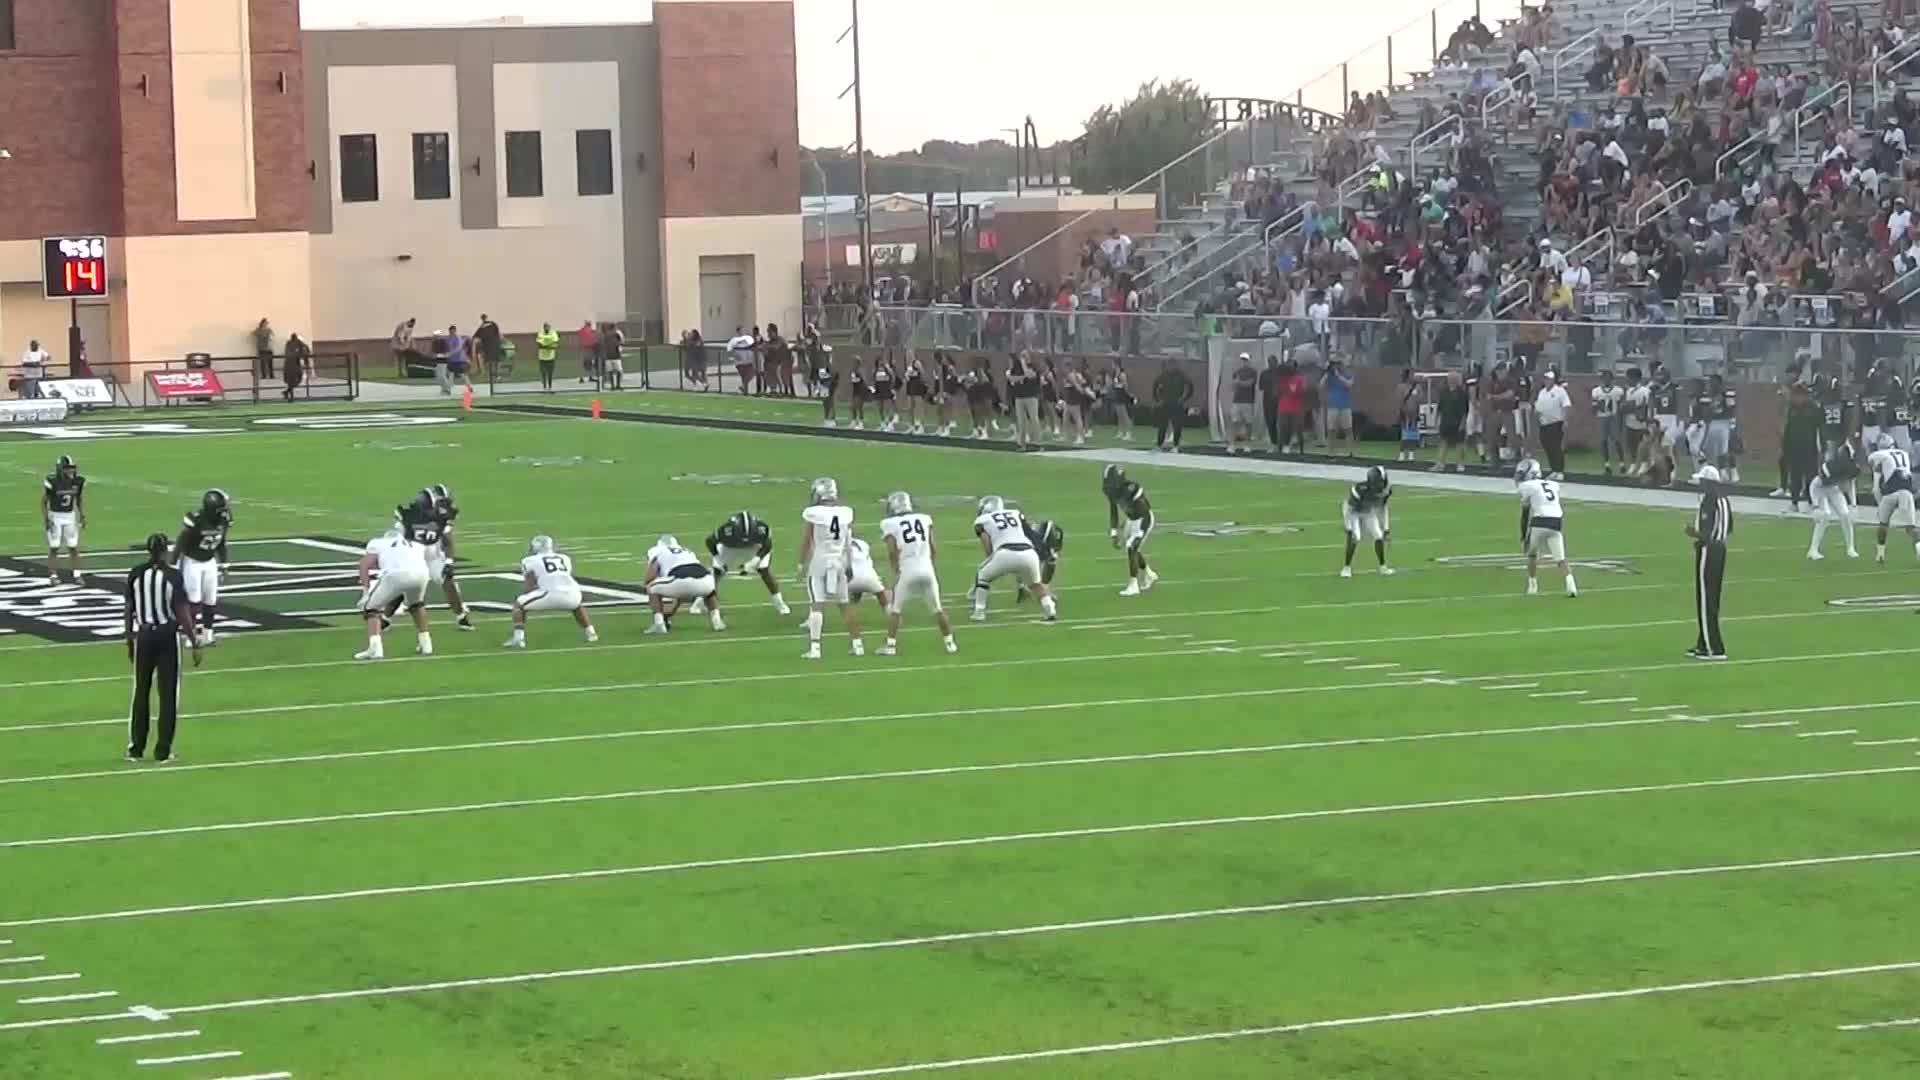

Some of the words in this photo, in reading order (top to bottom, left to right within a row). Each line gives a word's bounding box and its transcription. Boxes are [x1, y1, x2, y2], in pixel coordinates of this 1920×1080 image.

[59, 239, 103, 258] 9:56
[65, 261, 97, 292] 14
[1889, 451, 1907, 468] 17
[61, 494, 72, 507] 3
[1541, 482, 1556, 501] 5
[829, 515, 840, 540] 4
[900, 519, 927, 543] 24
[991, 513, 1018, 530] 56
[542, 556, 568, 574] 63
